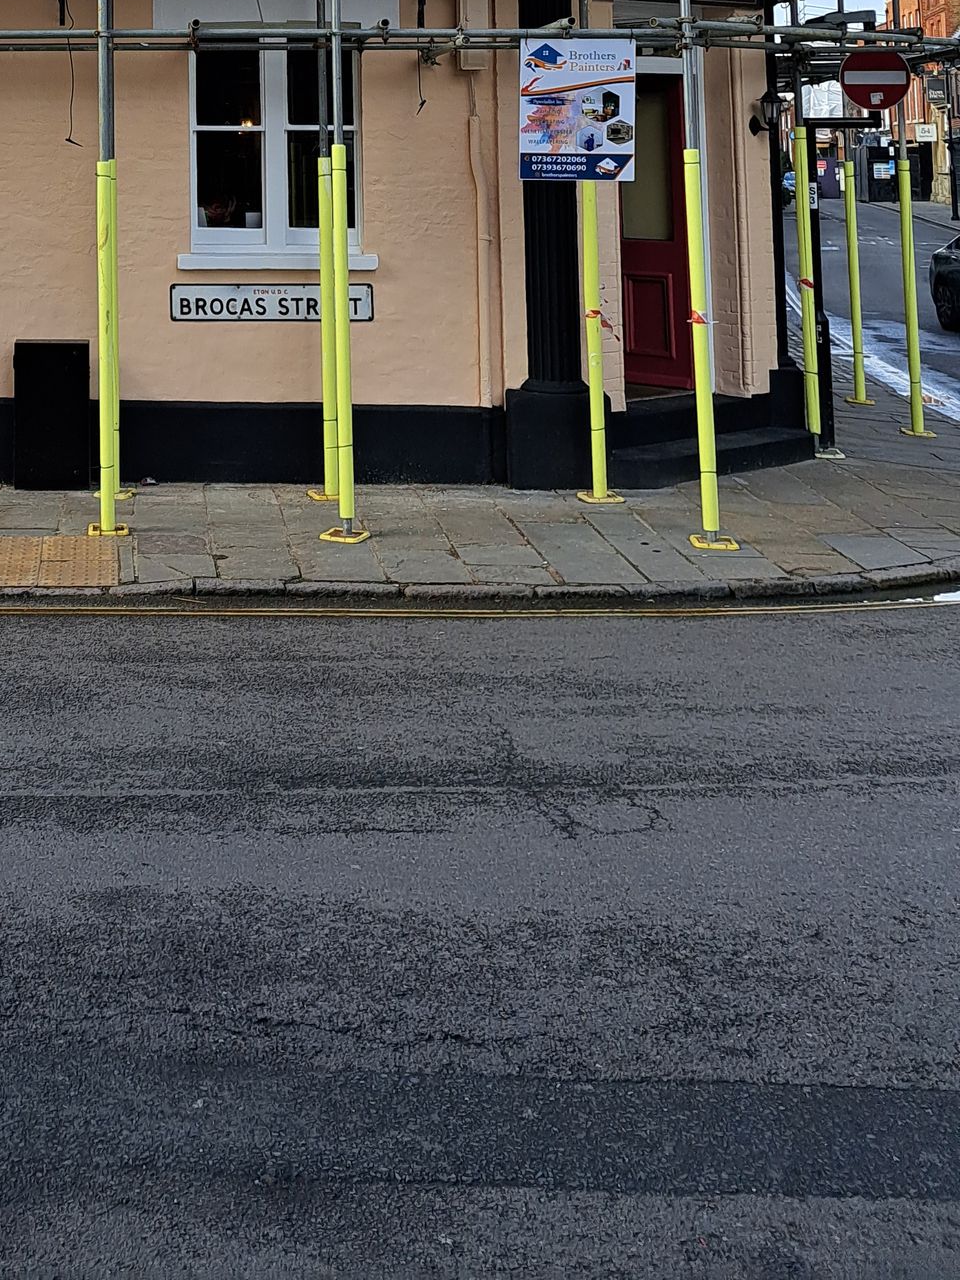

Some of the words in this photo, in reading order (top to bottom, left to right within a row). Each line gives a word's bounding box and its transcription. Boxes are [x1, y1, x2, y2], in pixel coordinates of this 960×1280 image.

[569, 50, 617, 61] Brothers
[569, 61, 616, 72] Painters
[531, 155, 587, 163] 07367202066
[531, 163, 587, 171] 07393670690
[180, 297, 267, 316] BROCAS
[278, 297, 362, 316] STRT
